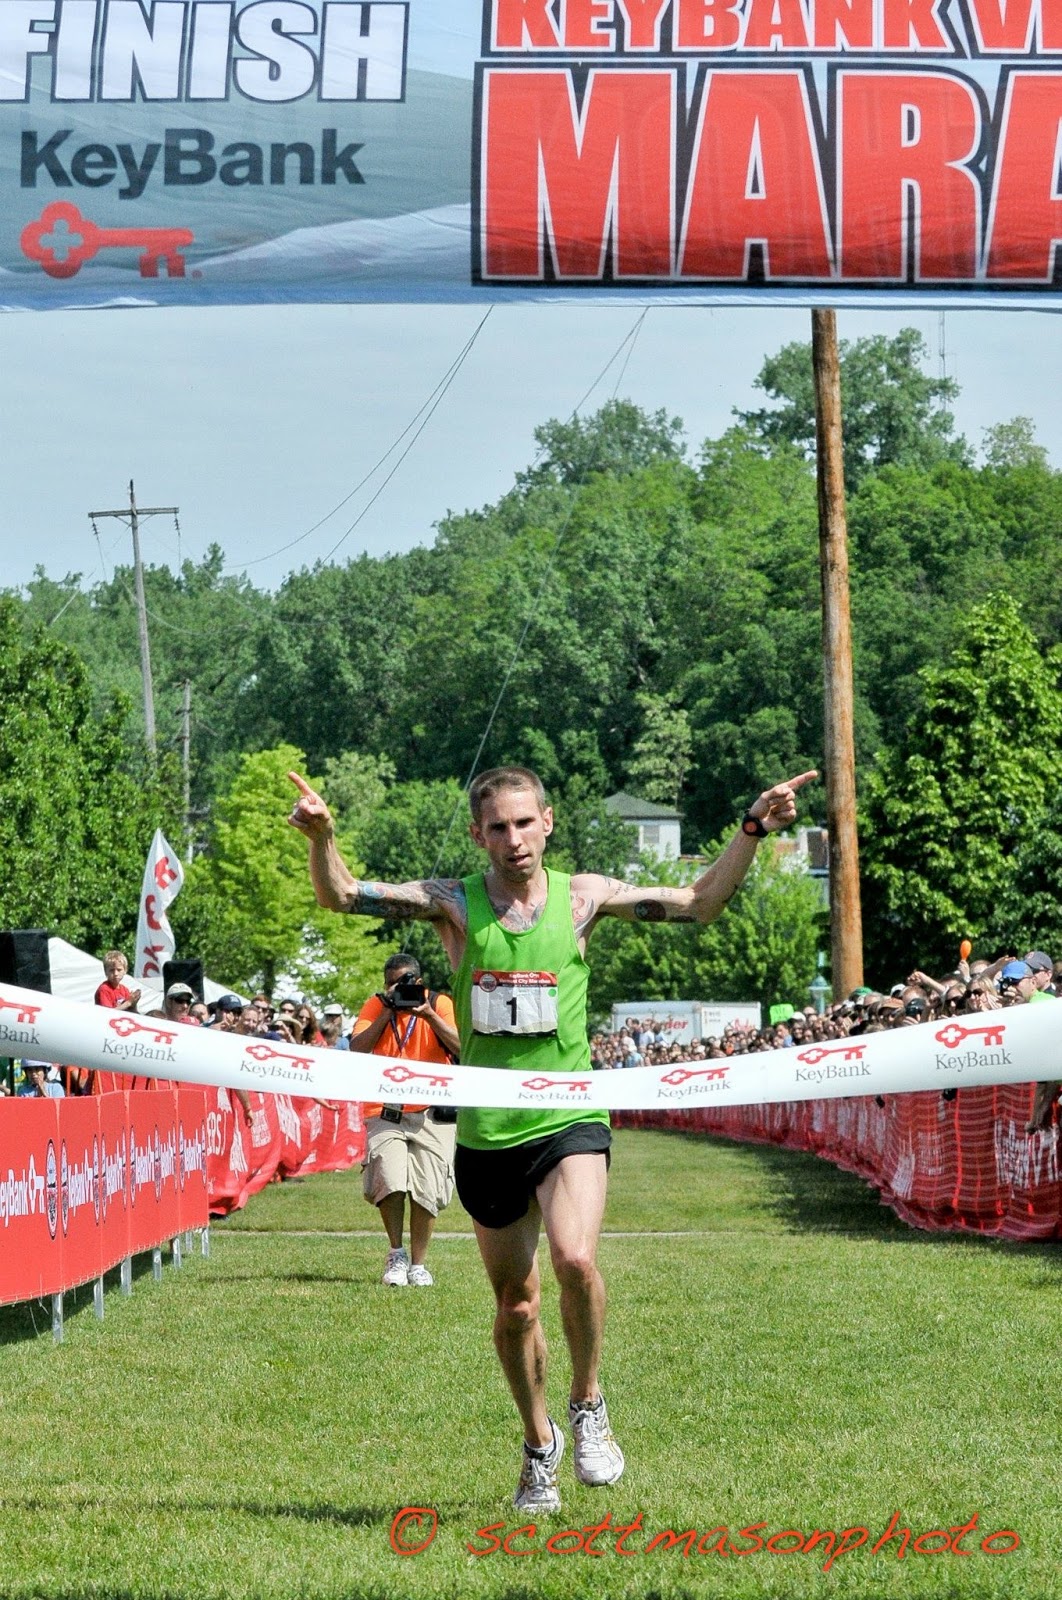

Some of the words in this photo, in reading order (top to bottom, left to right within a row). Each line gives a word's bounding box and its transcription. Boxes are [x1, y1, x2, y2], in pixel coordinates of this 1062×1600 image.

[483, 0, 957, 55] KEYBANK
[0, 0, 407, 103] FINISH
[20, 127, 366, 199] KeyBank
[506, 997, 517, 1026] 1
[102, 1038, 177, 1062] KeyBank
[935, 1048, 1013, 1072] KeyBank
[239, 1060, 314, 1083] KeyBank
[795, 1061, 871, 1083] KeyBank
[377, 1083, 452, 1098] KeyBank
[517, 1090, 592, 1101] KeyBank
[657, 1079, 731, 1100] KeyBank
